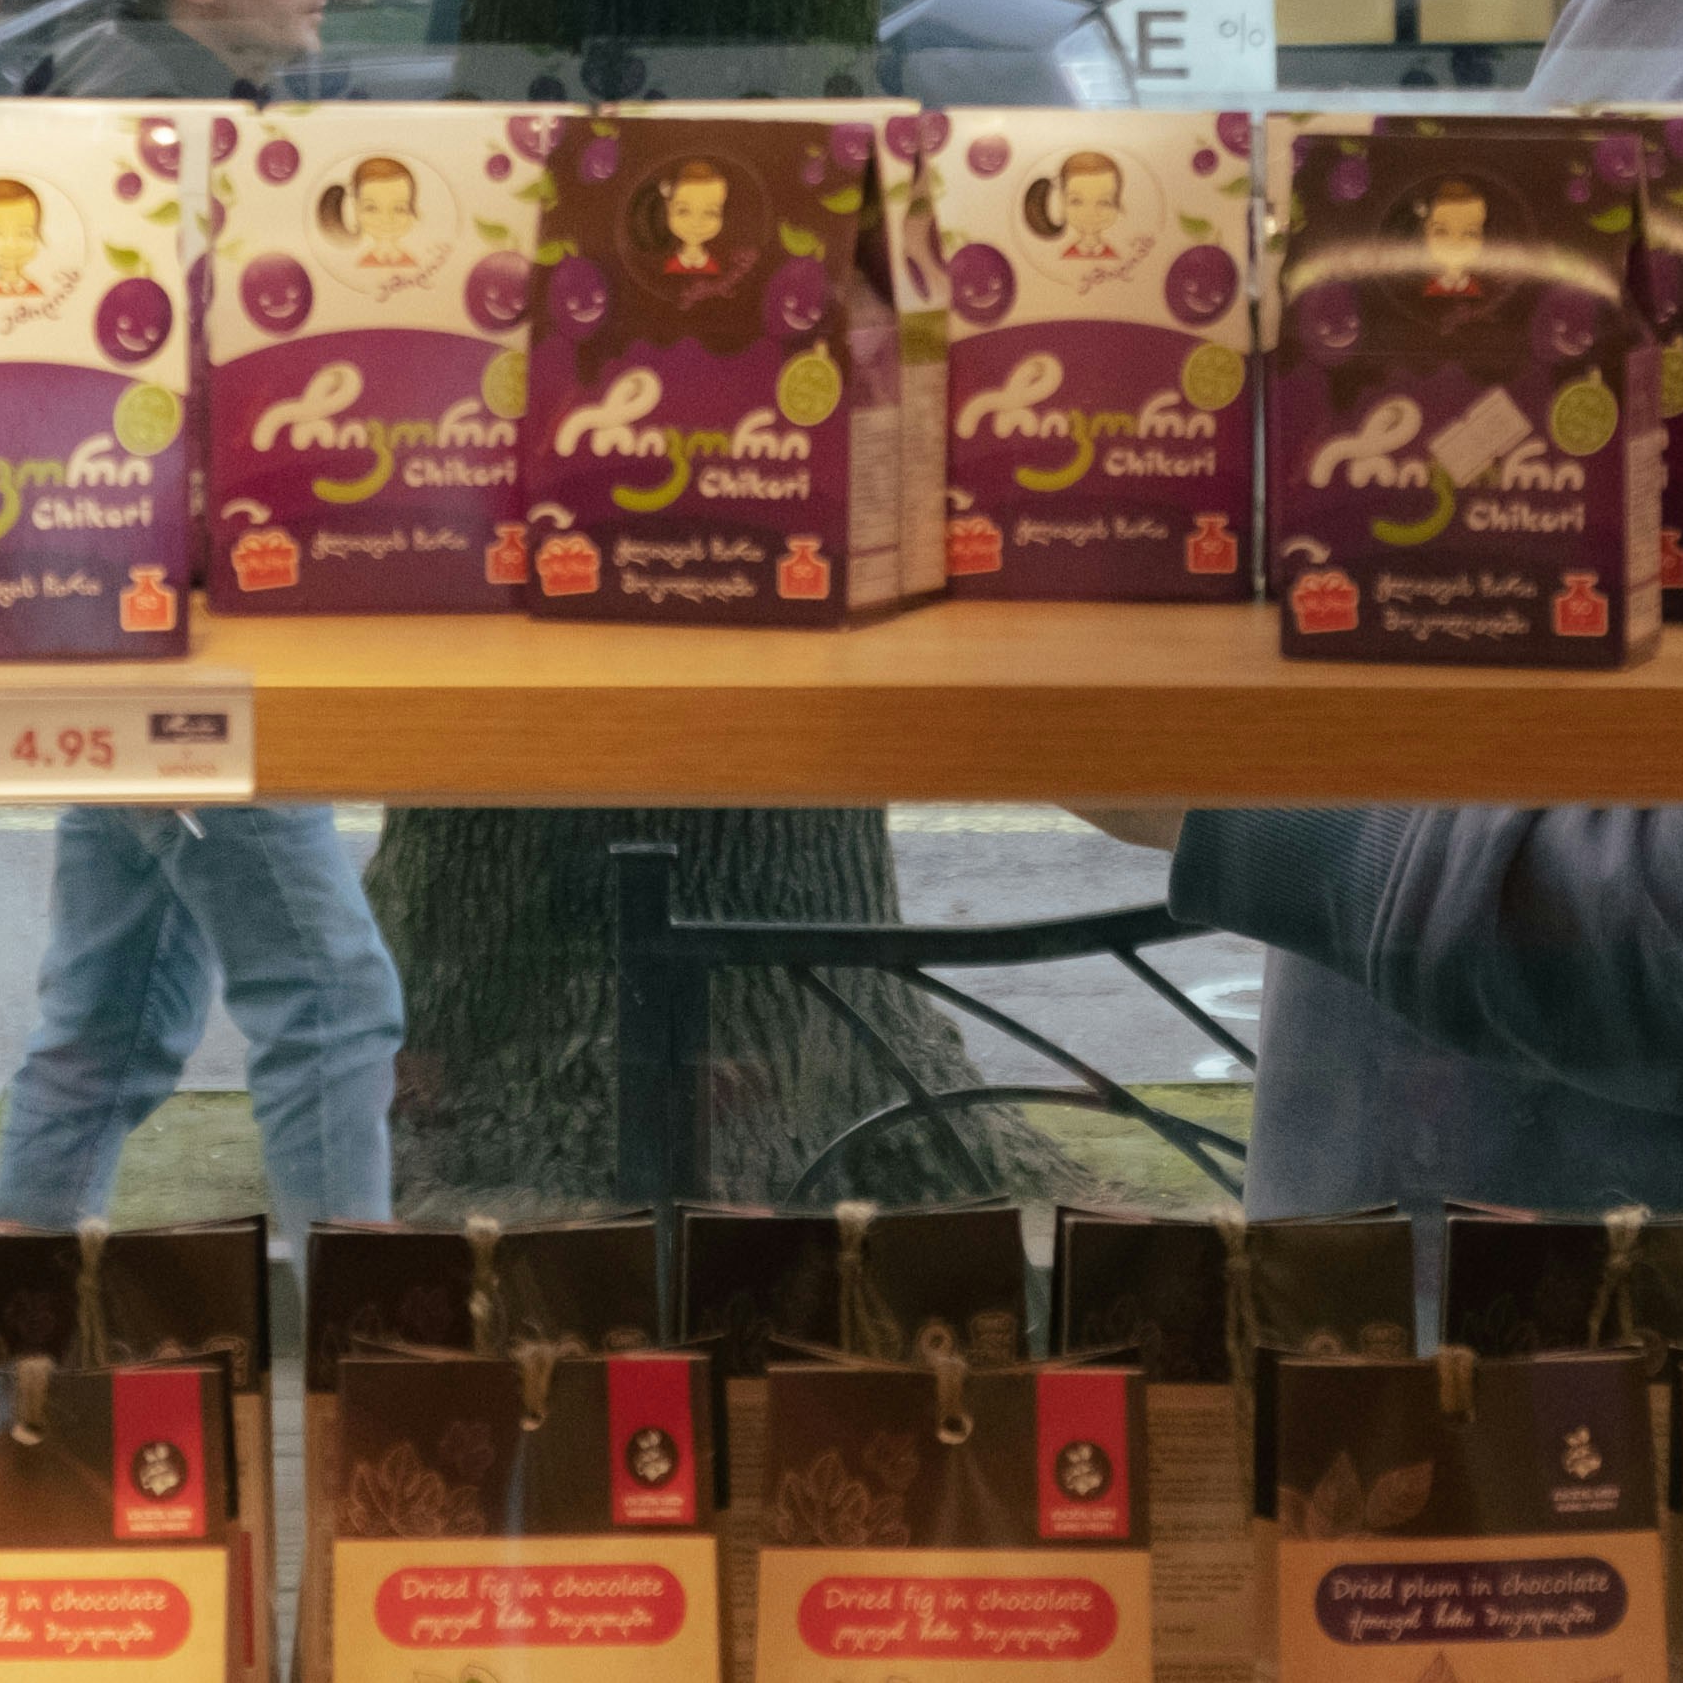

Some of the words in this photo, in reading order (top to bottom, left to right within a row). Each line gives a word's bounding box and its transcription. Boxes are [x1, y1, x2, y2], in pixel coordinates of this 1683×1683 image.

[402, 456, 517, 487] Chikori
[1103, 447, 1217, 478] Chikori
[697, 465, 811, 500] Chikori
[30, 497, 154, 530] Chikori
[1464, 502, 1586, 533] Chikori
[11, 726, 116, 770] 4.95
[15, 1588, 42, 1612] in
[50, 1586, 168, 1614] chocolate
[400, 1574, 468, 1601] Dried
[478, 1573, 512, 1607] fig
[519, 1575, 544, 1599] in
[552, 1573, 664, 1600] chocolate
[824, 1586, 893, 1612] Dried
[902, 1586, 933, 1621] fig
[941, 1587, 968, 1611] in
[977, 1584, 1094, 1613] chocolate
[1332, 1576, 1395, 1601] Dried
[1401, 1573, 1461, 1610] plum
[1470, 1573, 1493, 1596] in
[1501, 1569, 1611, 1597] chocolate
